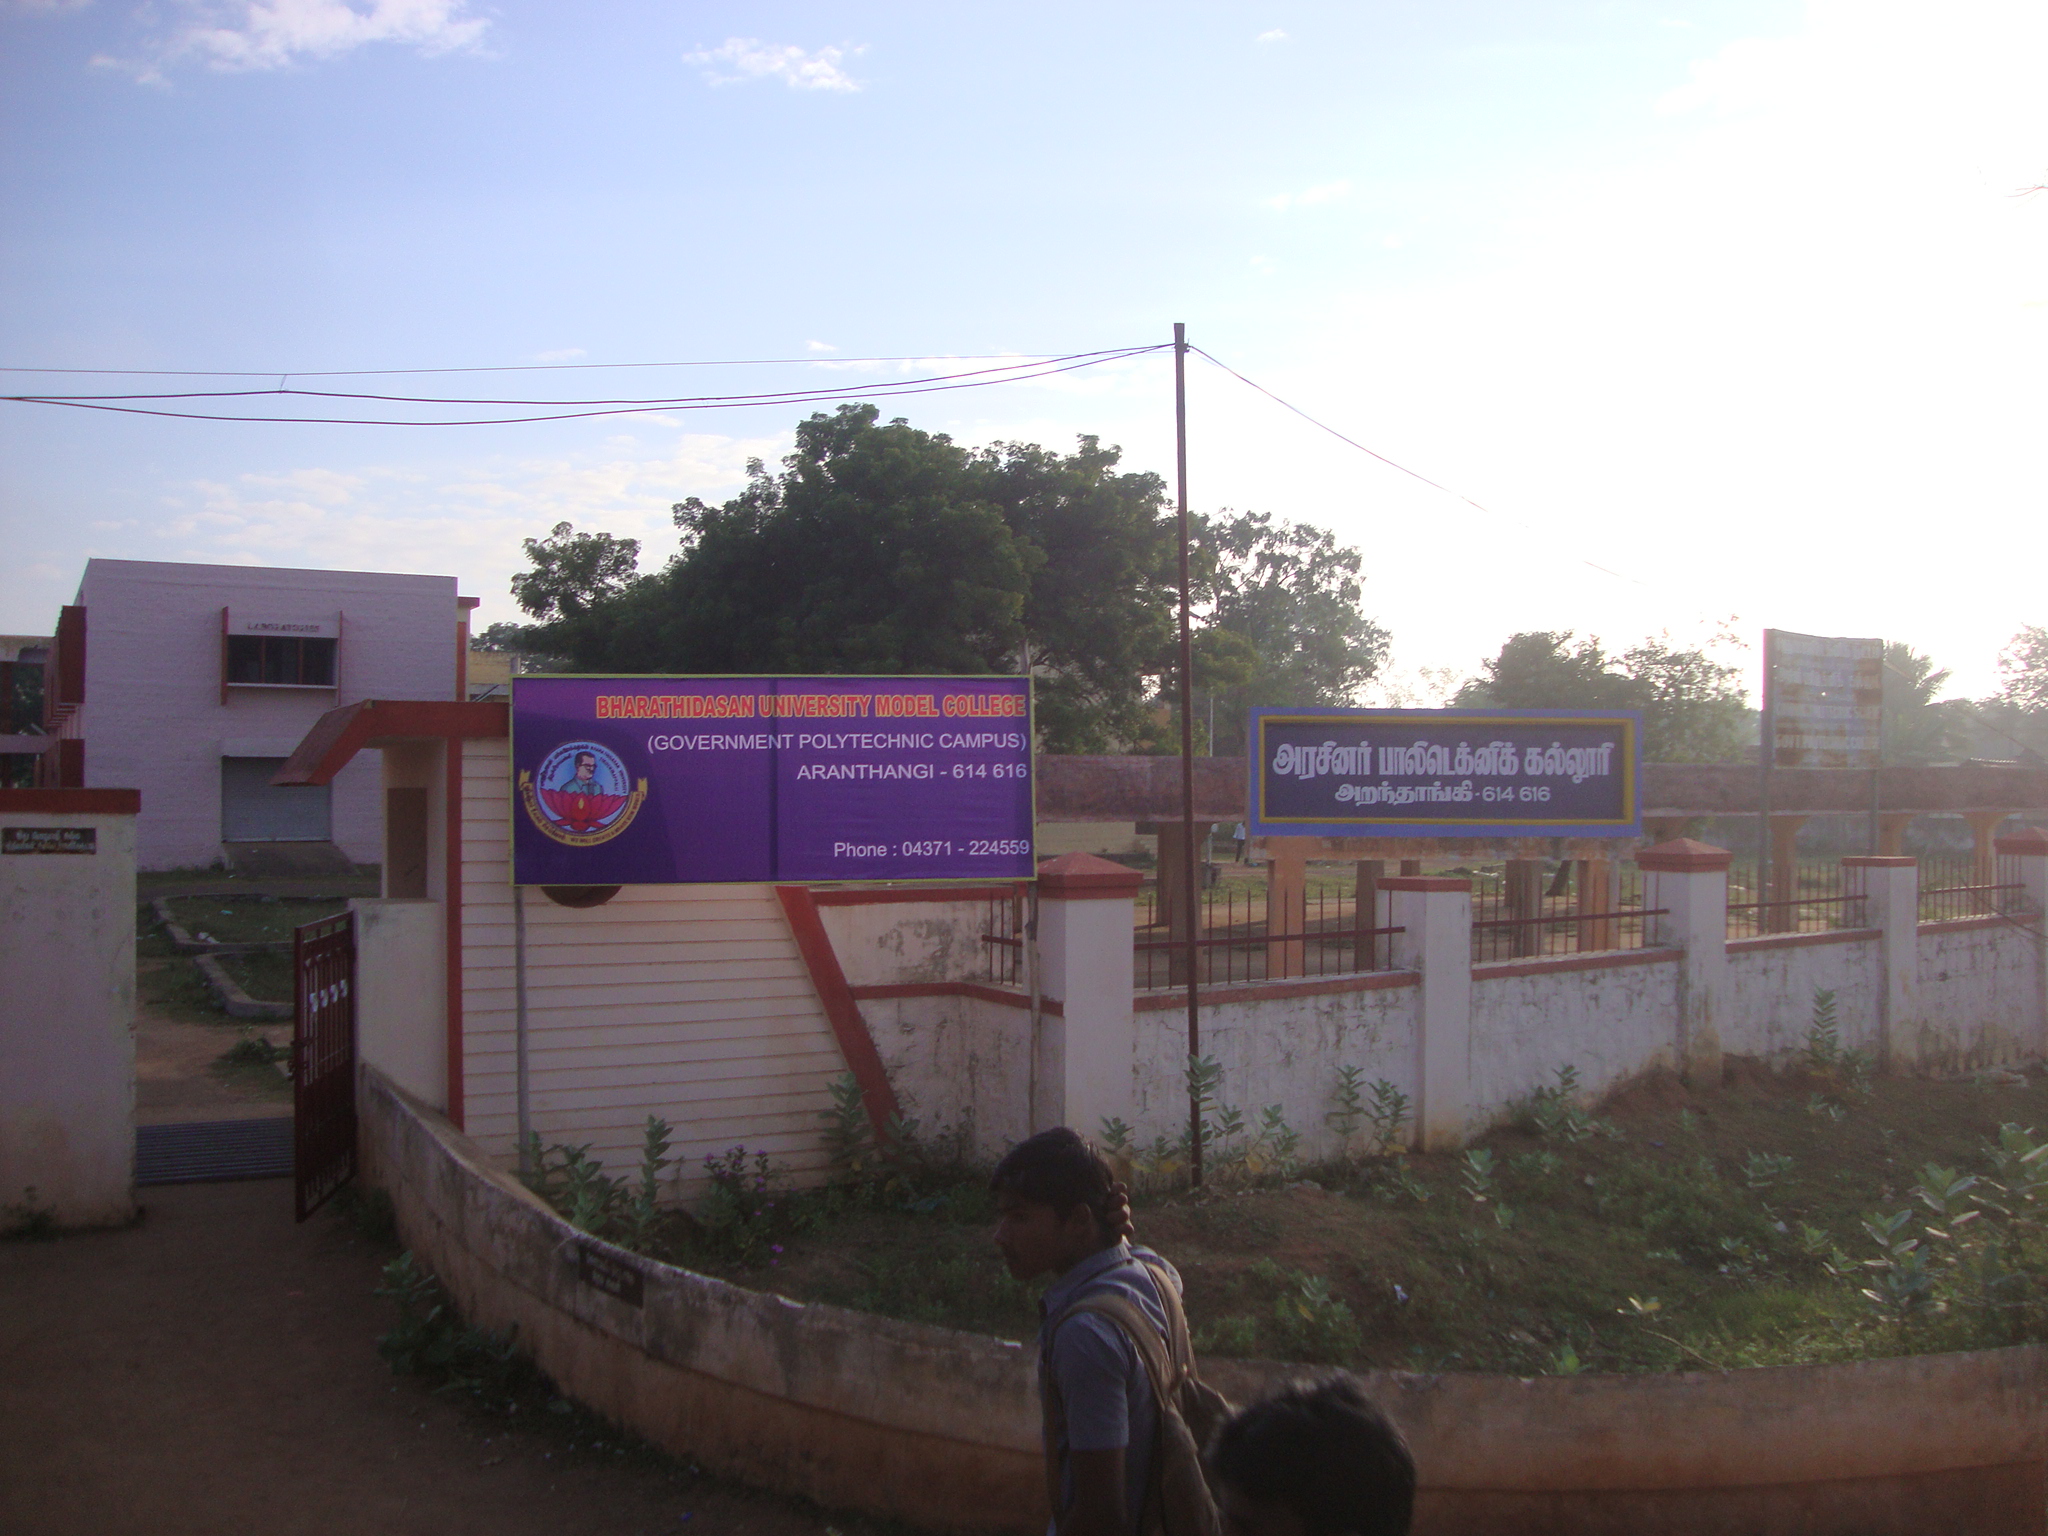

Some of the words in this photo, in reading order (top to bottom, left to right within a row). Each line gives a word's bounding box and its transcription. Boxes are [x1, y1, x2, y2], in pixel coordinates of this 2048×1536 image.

[596, 695, 755, 719] BHARATHIDASAN
[758, 695, 871, 718] UNIVERSITY
[875, 695, 939, 717] MODEL
[942, 694, 1027, 717] COLLEGE
[647, 733, 794, 752] (GOVERNMENT
[799, 733, 934, 750] POLYTECHNIC
[940, 733, 1027, 751] CAMPUS)
[1273, 740, 1372, 780] அரசினர்
[1378, 740, 1519, 777] பாலிடெக்னிக்
[1523, 741, 1616, 784] கல்லூரி
[797, 764, 934, 780] ARANTHANGI
[952, 764, 987, 779] 614
[992, 763, 1028, 779] 616
[1519, 786, 1551, 802] 616
[834, 842, 888, 857] Phone
[902, 841, 952, 856] 04371
[969, 840, 1030, 856] 224559
